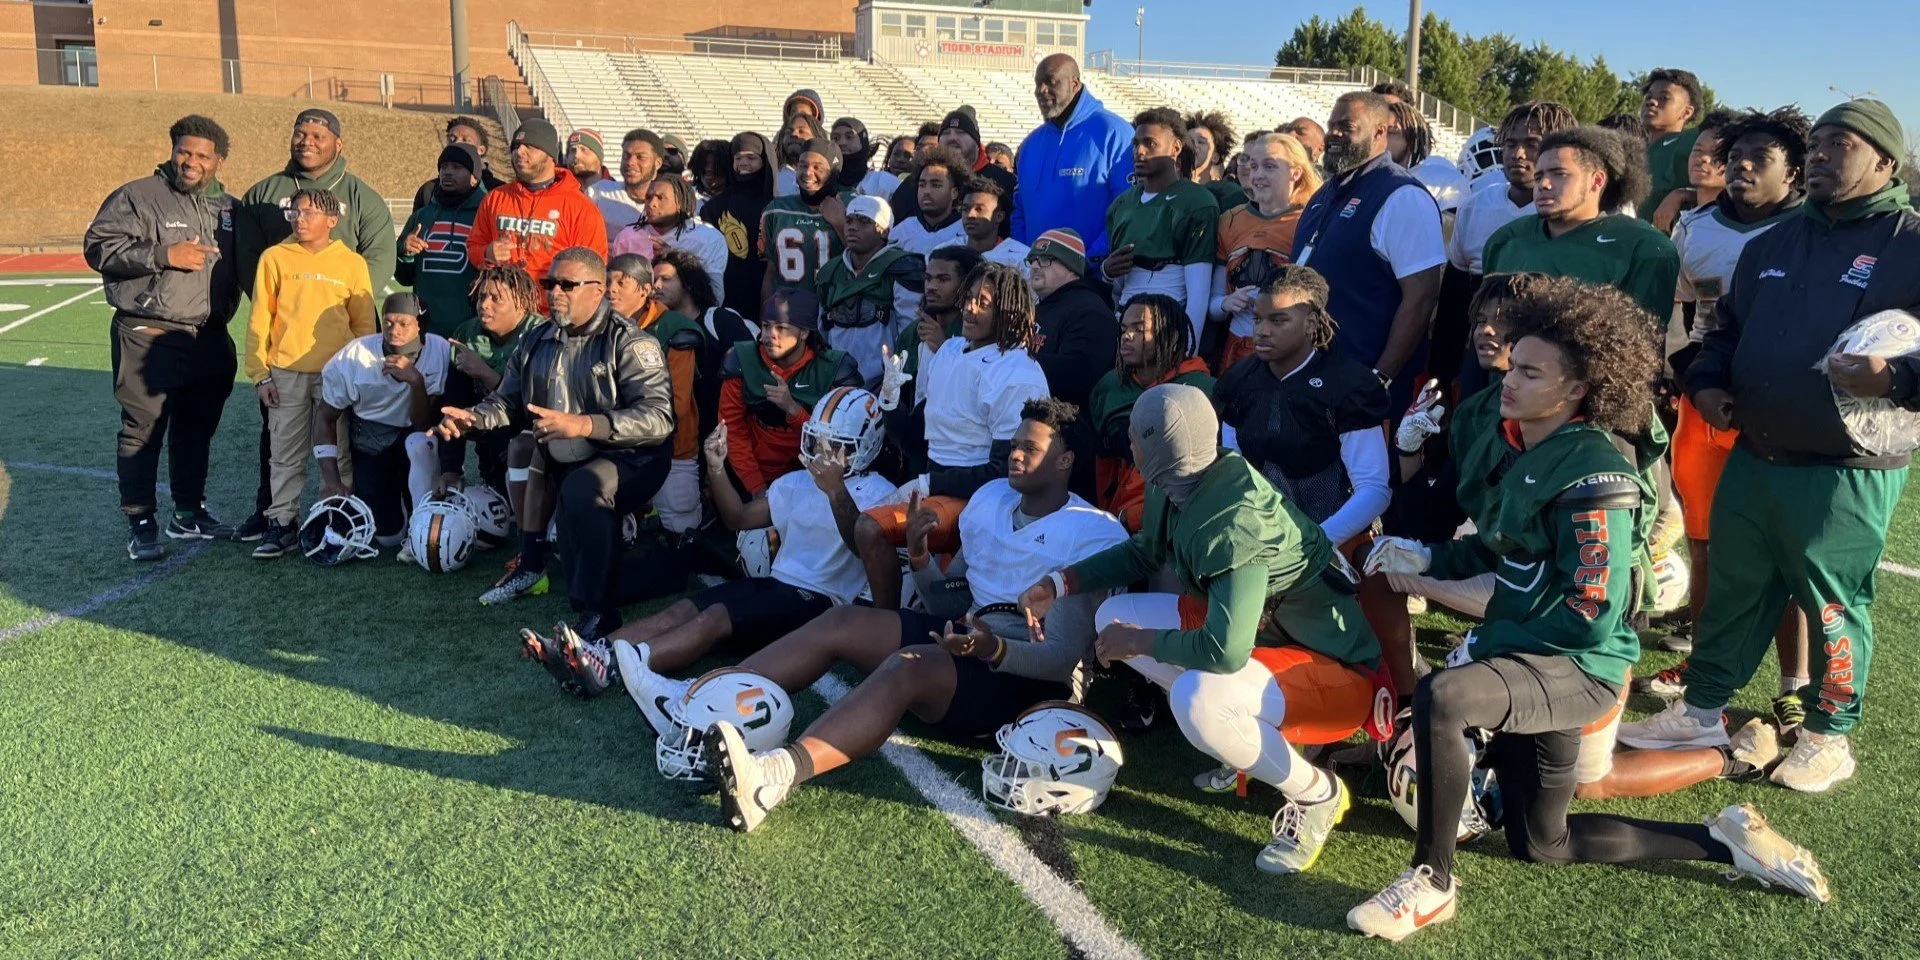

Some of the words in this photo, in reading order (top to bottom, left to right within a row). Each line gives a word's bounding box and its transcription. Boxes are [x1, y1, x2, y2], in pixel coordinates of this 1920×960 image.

[941, 42, 972, 54] TIGER
[973, 44, 1023, 56] STADIUM
[497, 215, 557, 236] TIGER
[777, 228, 830, 281] 61
[1566, 508, 1610, 621] TIGERS
